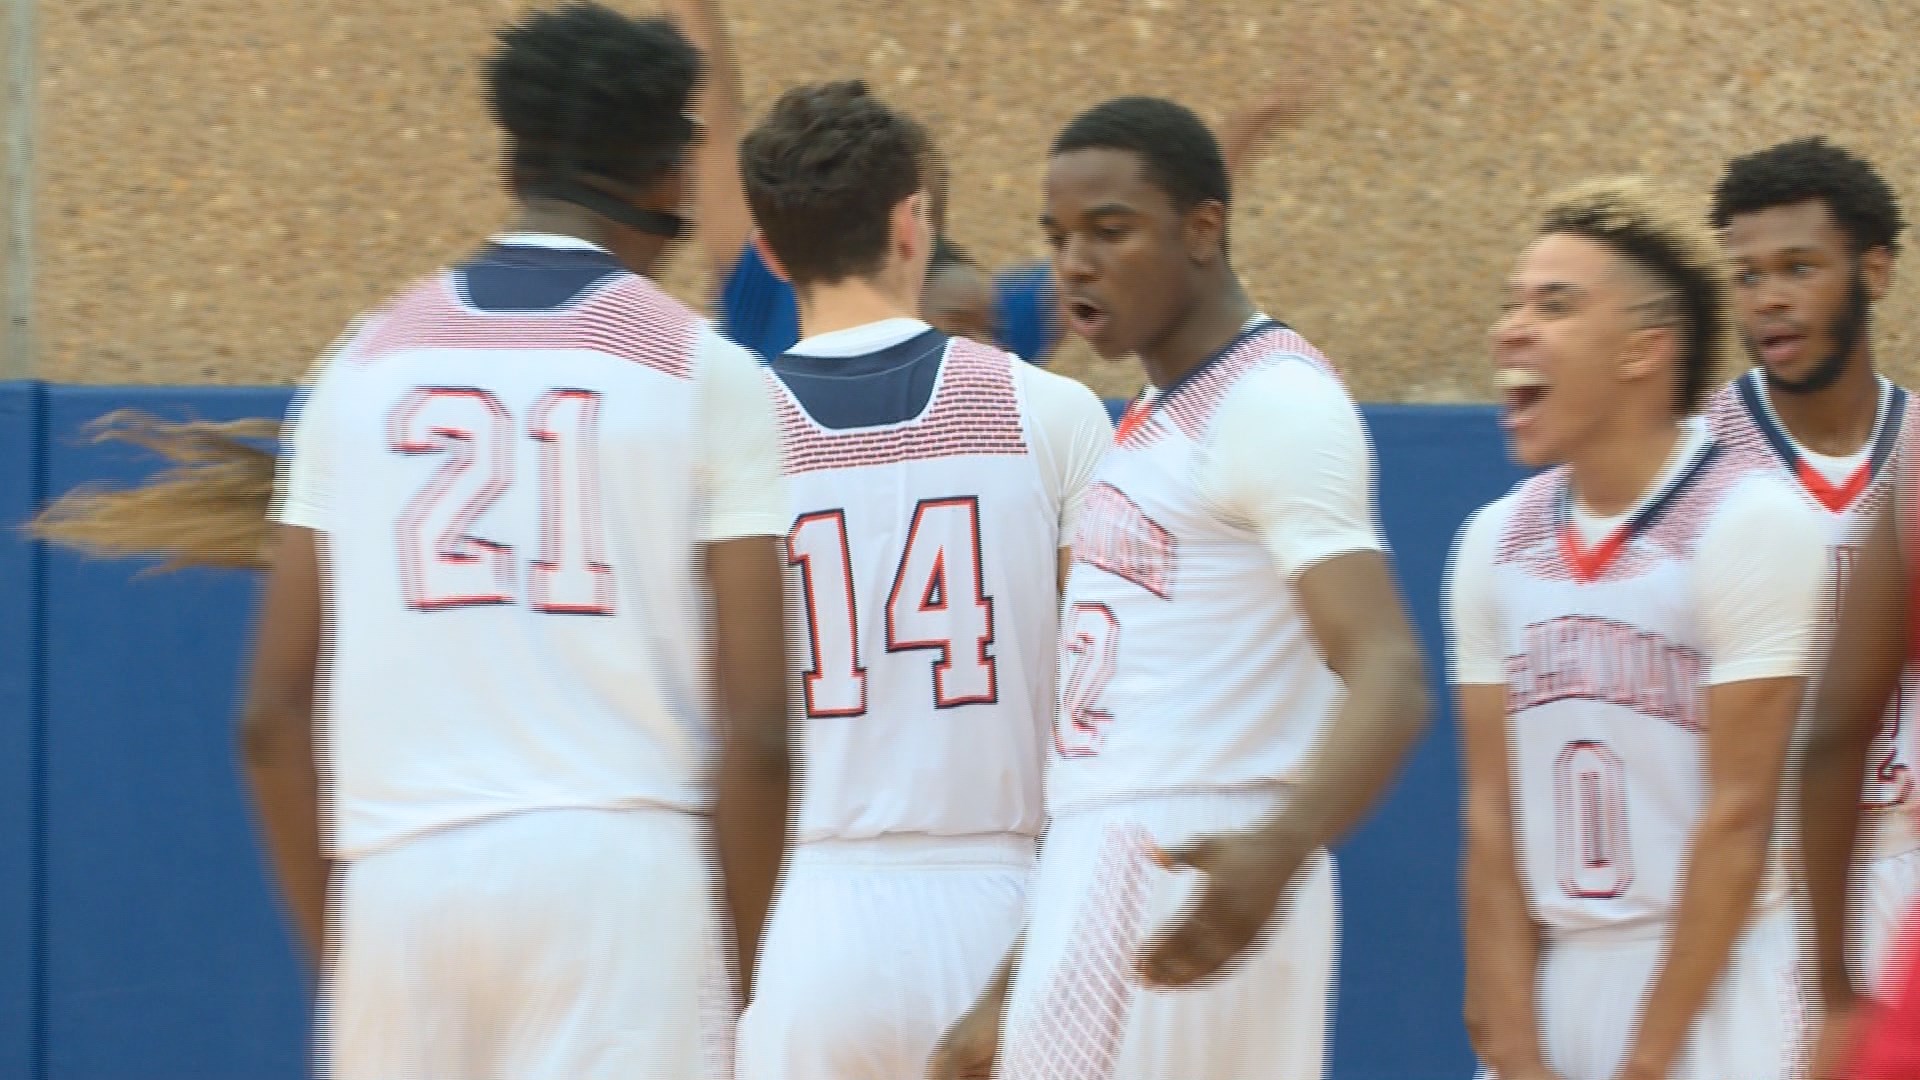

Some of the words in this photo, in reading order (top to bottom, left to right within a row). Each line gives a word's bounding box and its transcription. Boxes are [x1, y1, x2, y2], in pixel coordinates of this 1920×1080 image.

[385, 384, 618, 616] 21
[785, 494, 999, 719] 14
[1553, 739, 1636, 899] 0
